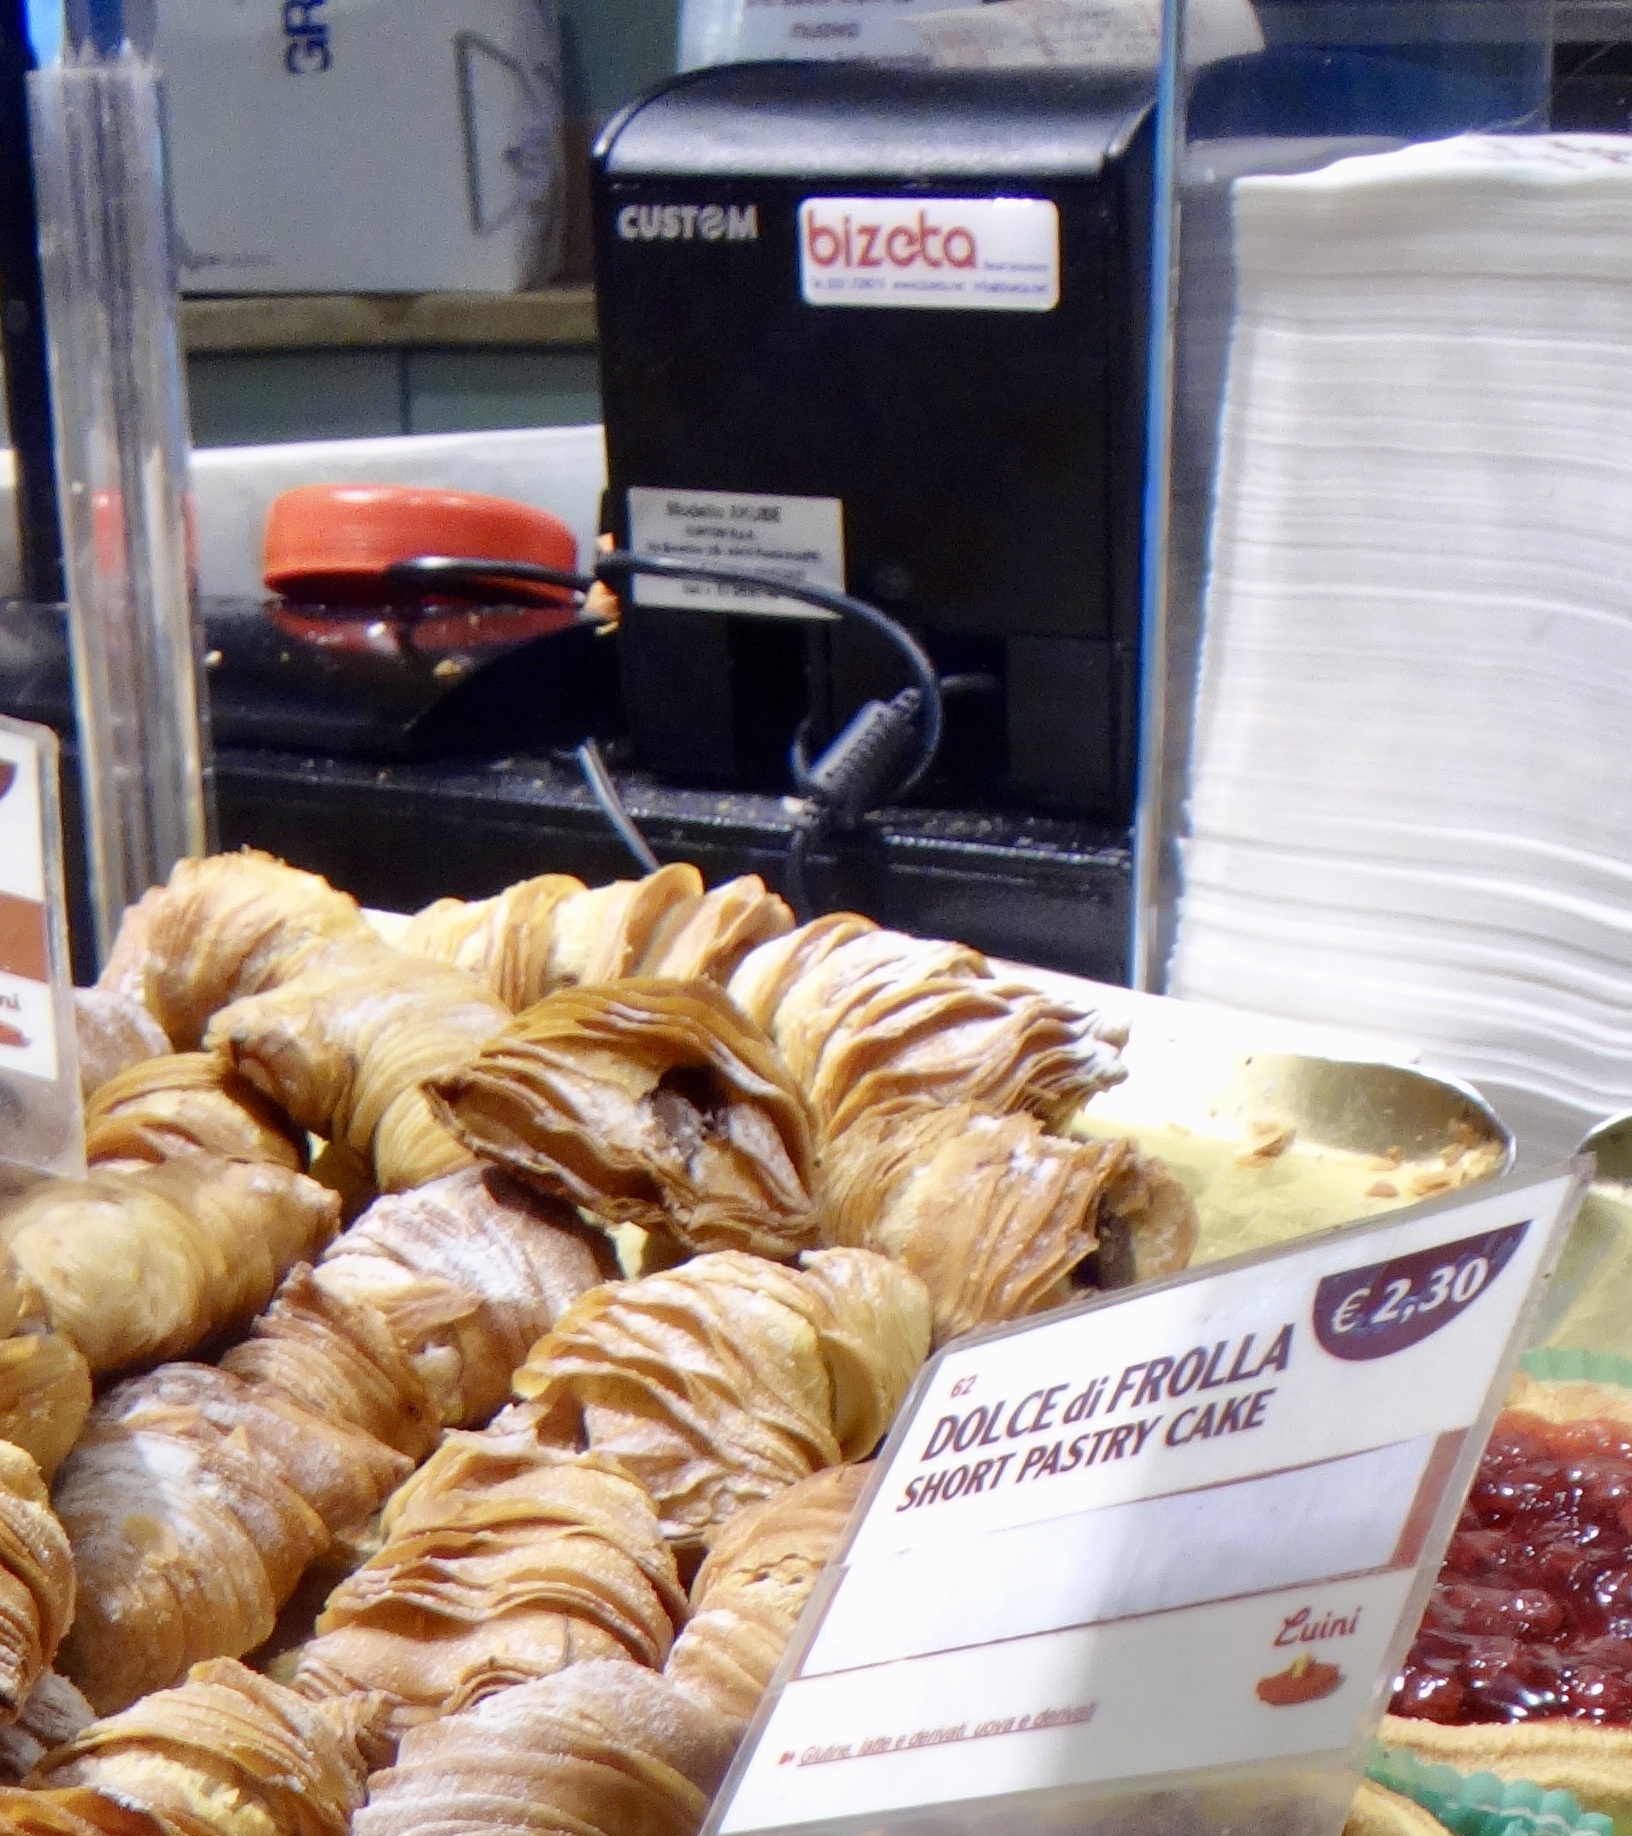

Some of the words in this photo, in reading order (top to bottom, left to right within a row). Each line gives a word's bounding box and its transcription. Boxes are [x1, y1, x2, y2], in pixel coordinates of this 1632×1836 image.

[807, 209, 977, 268] bizeta
[1331, 1287, 1371, 1334] €
[1370, 1256, 1489, 1325] 2,30
[920, 1382, 1071, 1463] DOLCE
[1062, 1375, 1109, 1426] di
[1105, 1323, 1295, 1414] FROLLA
[949, 1375, 978, 1400] 62
[895, 1452, 1017, 1513] SHORT
[1015, 1415, 1164, 1485] PASTRY
[1164, 1387, 1278, 1448] CAKE
[1273, 1605, 1363, 1647] Luini
